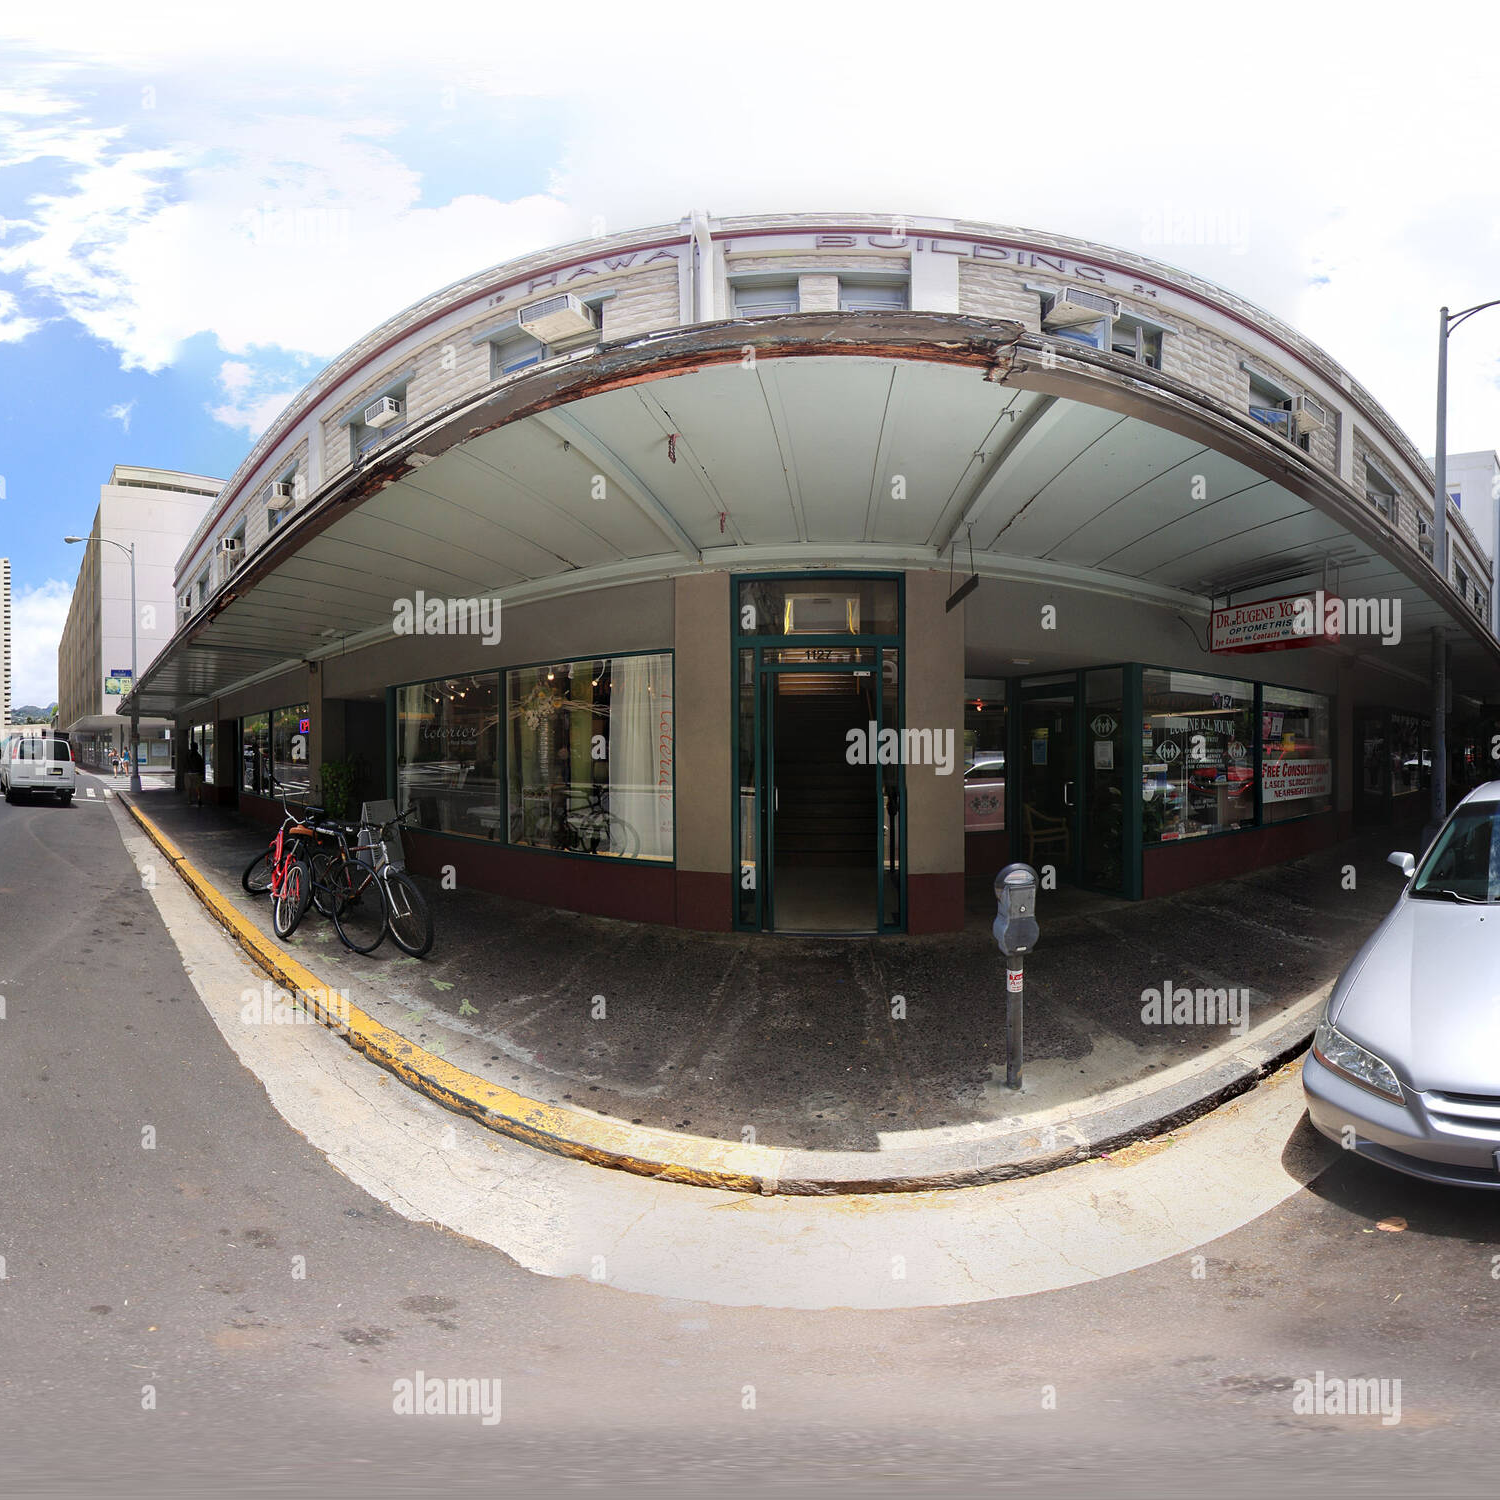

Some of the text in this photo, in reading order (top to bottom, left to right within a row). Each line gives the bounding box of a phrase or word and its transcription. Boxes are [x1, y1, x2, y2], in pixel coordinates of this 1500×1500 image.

[816, 235, 1106, 283] BUILDING
[1235, 606, 1275, 625] EUGENE
[1229, 614, 1301, 635] OPTOMETRIS
[1252, 631, 1280, 641] Contacts
[805, 649, 832, 660] 1127
[1214, 720, 1236, 737] YOUNG
[1262, 763, 1281, 778] FREE
[1264, 780, 1285, 789] LASER
